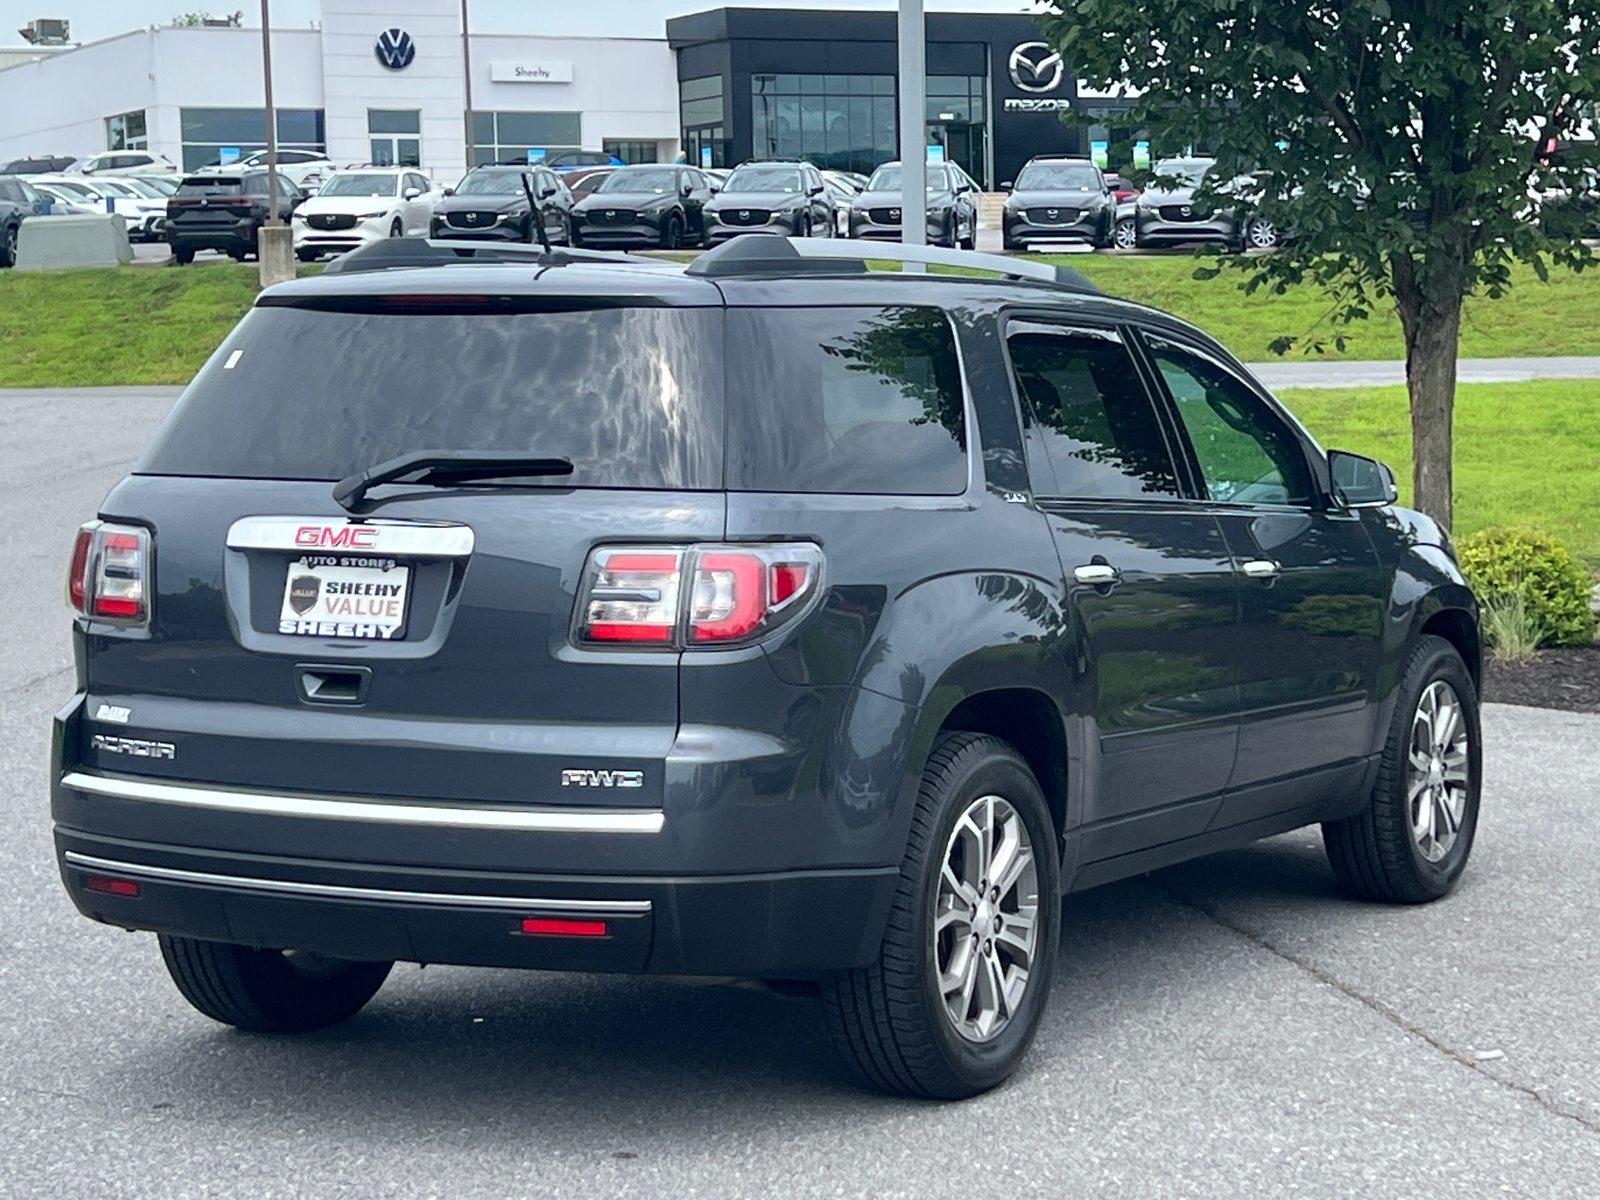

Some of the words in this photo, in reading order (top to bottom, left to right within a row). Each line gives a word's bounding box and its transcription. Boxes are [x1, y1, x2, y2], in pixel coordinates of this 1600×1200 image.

[515, 66, 550, 79] Sheehy
[295, 526, 379, 548] GMC
[300, 556, 337, 567] AUTO
[326, 582, 402, 597] SHEEHY
[326, 597, 399, 617] VALUE
[279, 620, 397, 639] SHEEHY
[91, 734, 176, 760] ACADIA
[561, 769, 644, 788] AWD
